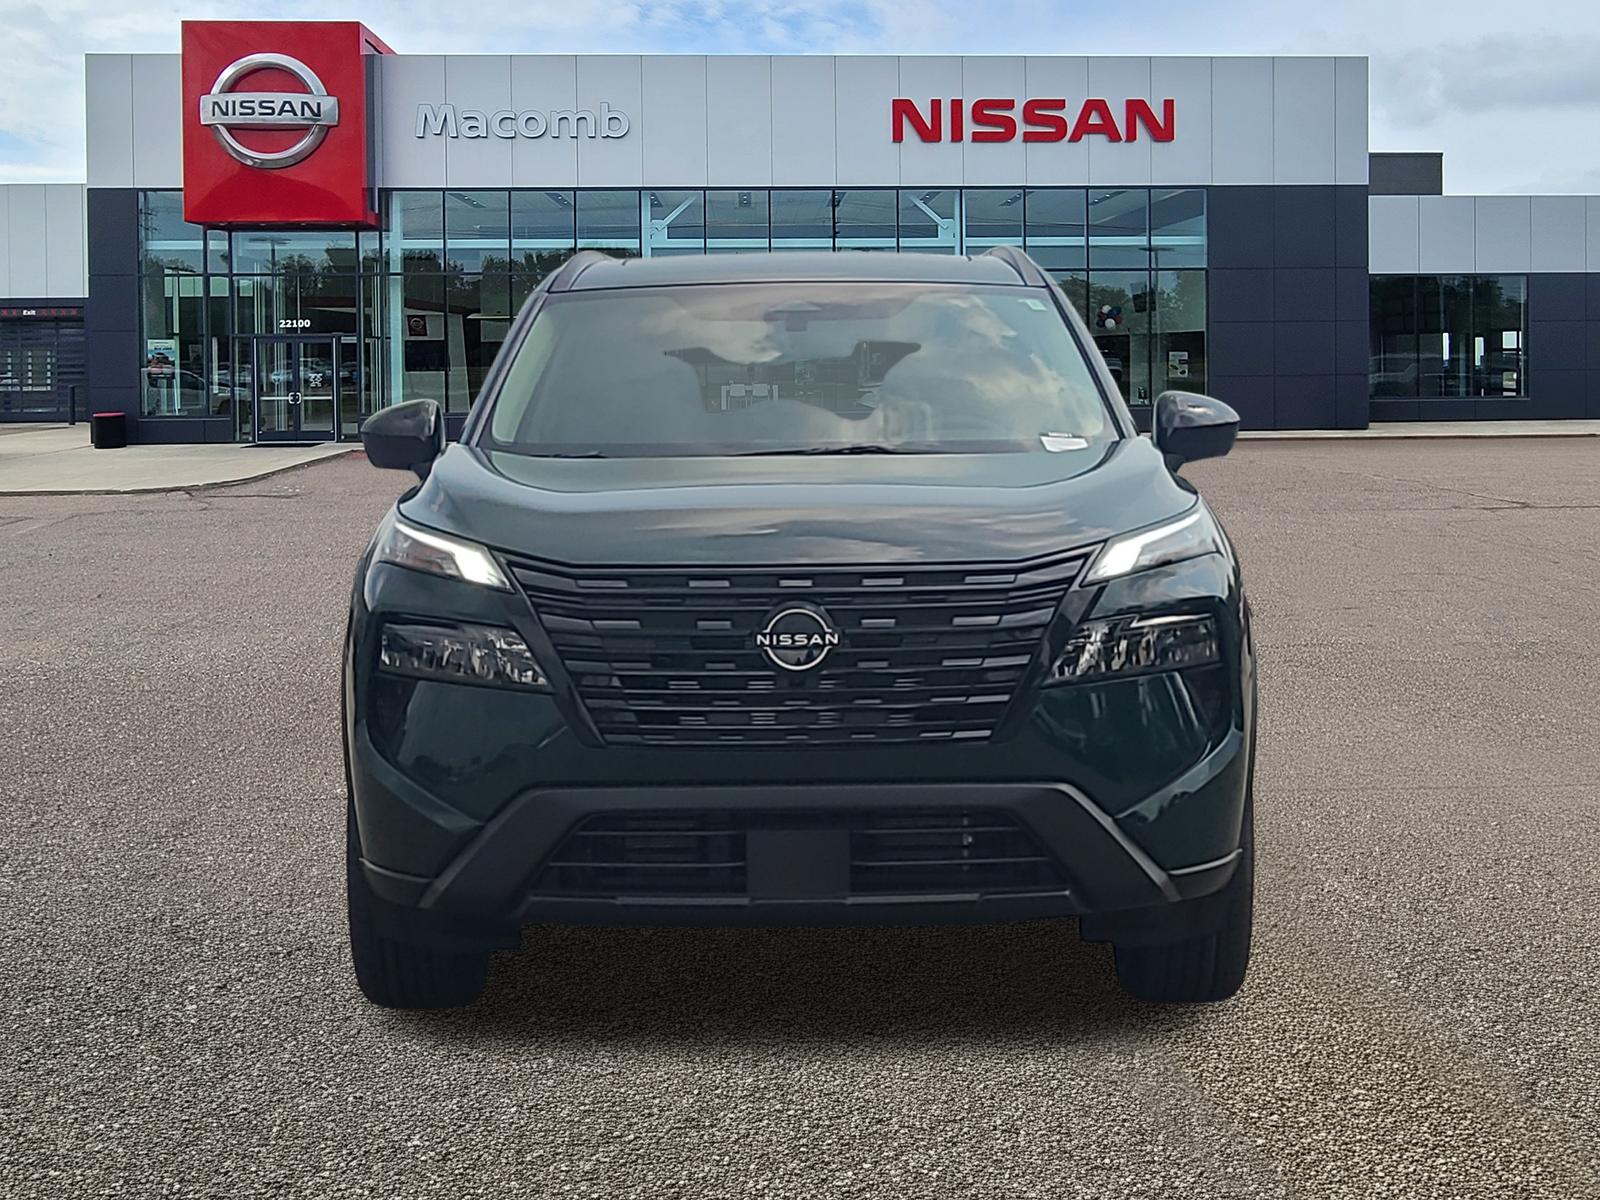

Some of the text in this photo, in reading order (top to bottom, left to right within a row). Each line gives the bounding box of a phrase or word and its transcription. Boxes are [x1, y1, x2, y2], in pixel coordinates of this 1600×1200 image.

[211, 100, 322, 118] NISSAN
[415, 101, 630, 139] Macomb
[891, 98, 1175, 143] NISSAN
[279, 319, 311, 328] 22100
[756, 633, 839, 646] NISSAN
